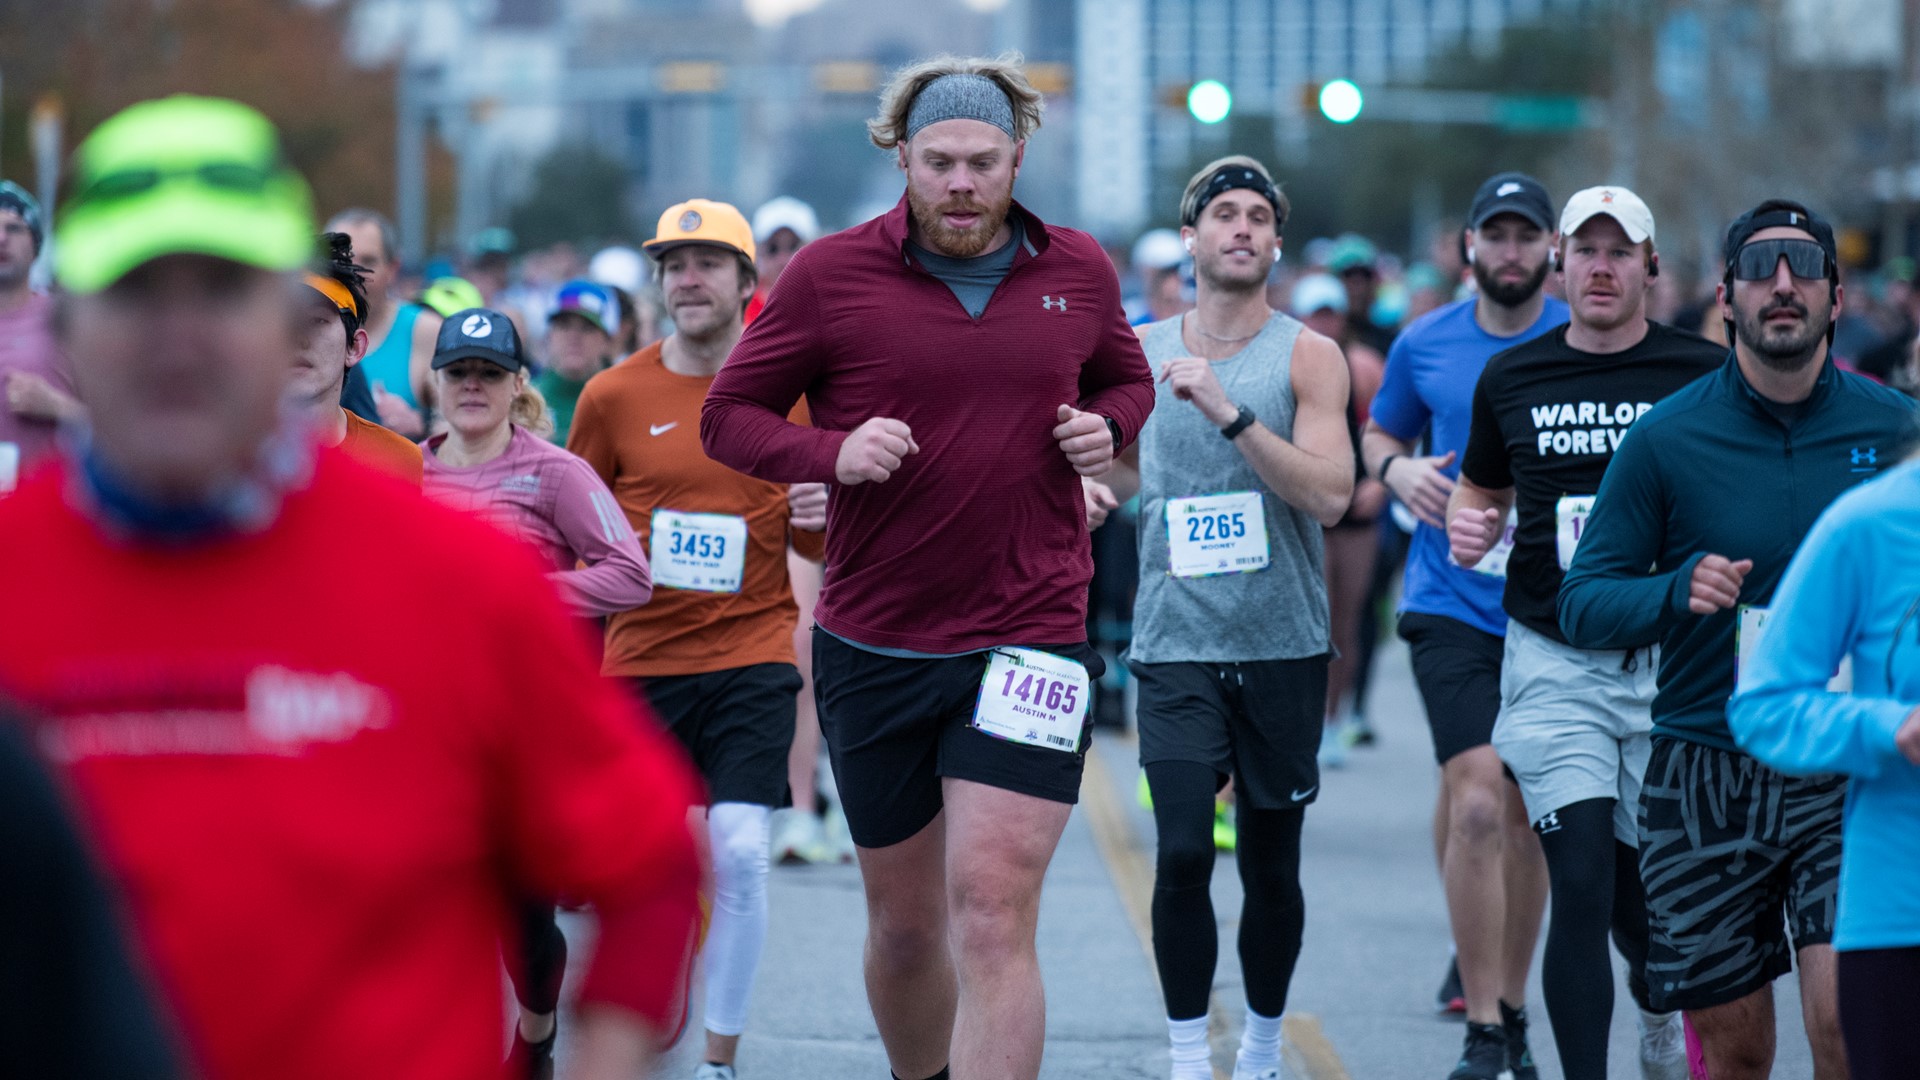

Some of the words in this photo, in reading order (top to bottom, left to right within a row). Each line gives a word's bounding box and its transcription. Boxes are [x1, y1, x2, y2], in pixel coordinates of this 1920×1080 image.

[1187, 512, 1245, 542] 2265
[669, 531, 725, 559] 3453
[1201, 542, 1236, 550] MOONEY
[1026, 664, 1045, 672] AUSTIN
[1002, 669, 1079, 714] 14165
[1012, 704, 1047, 720] AUSTIN
